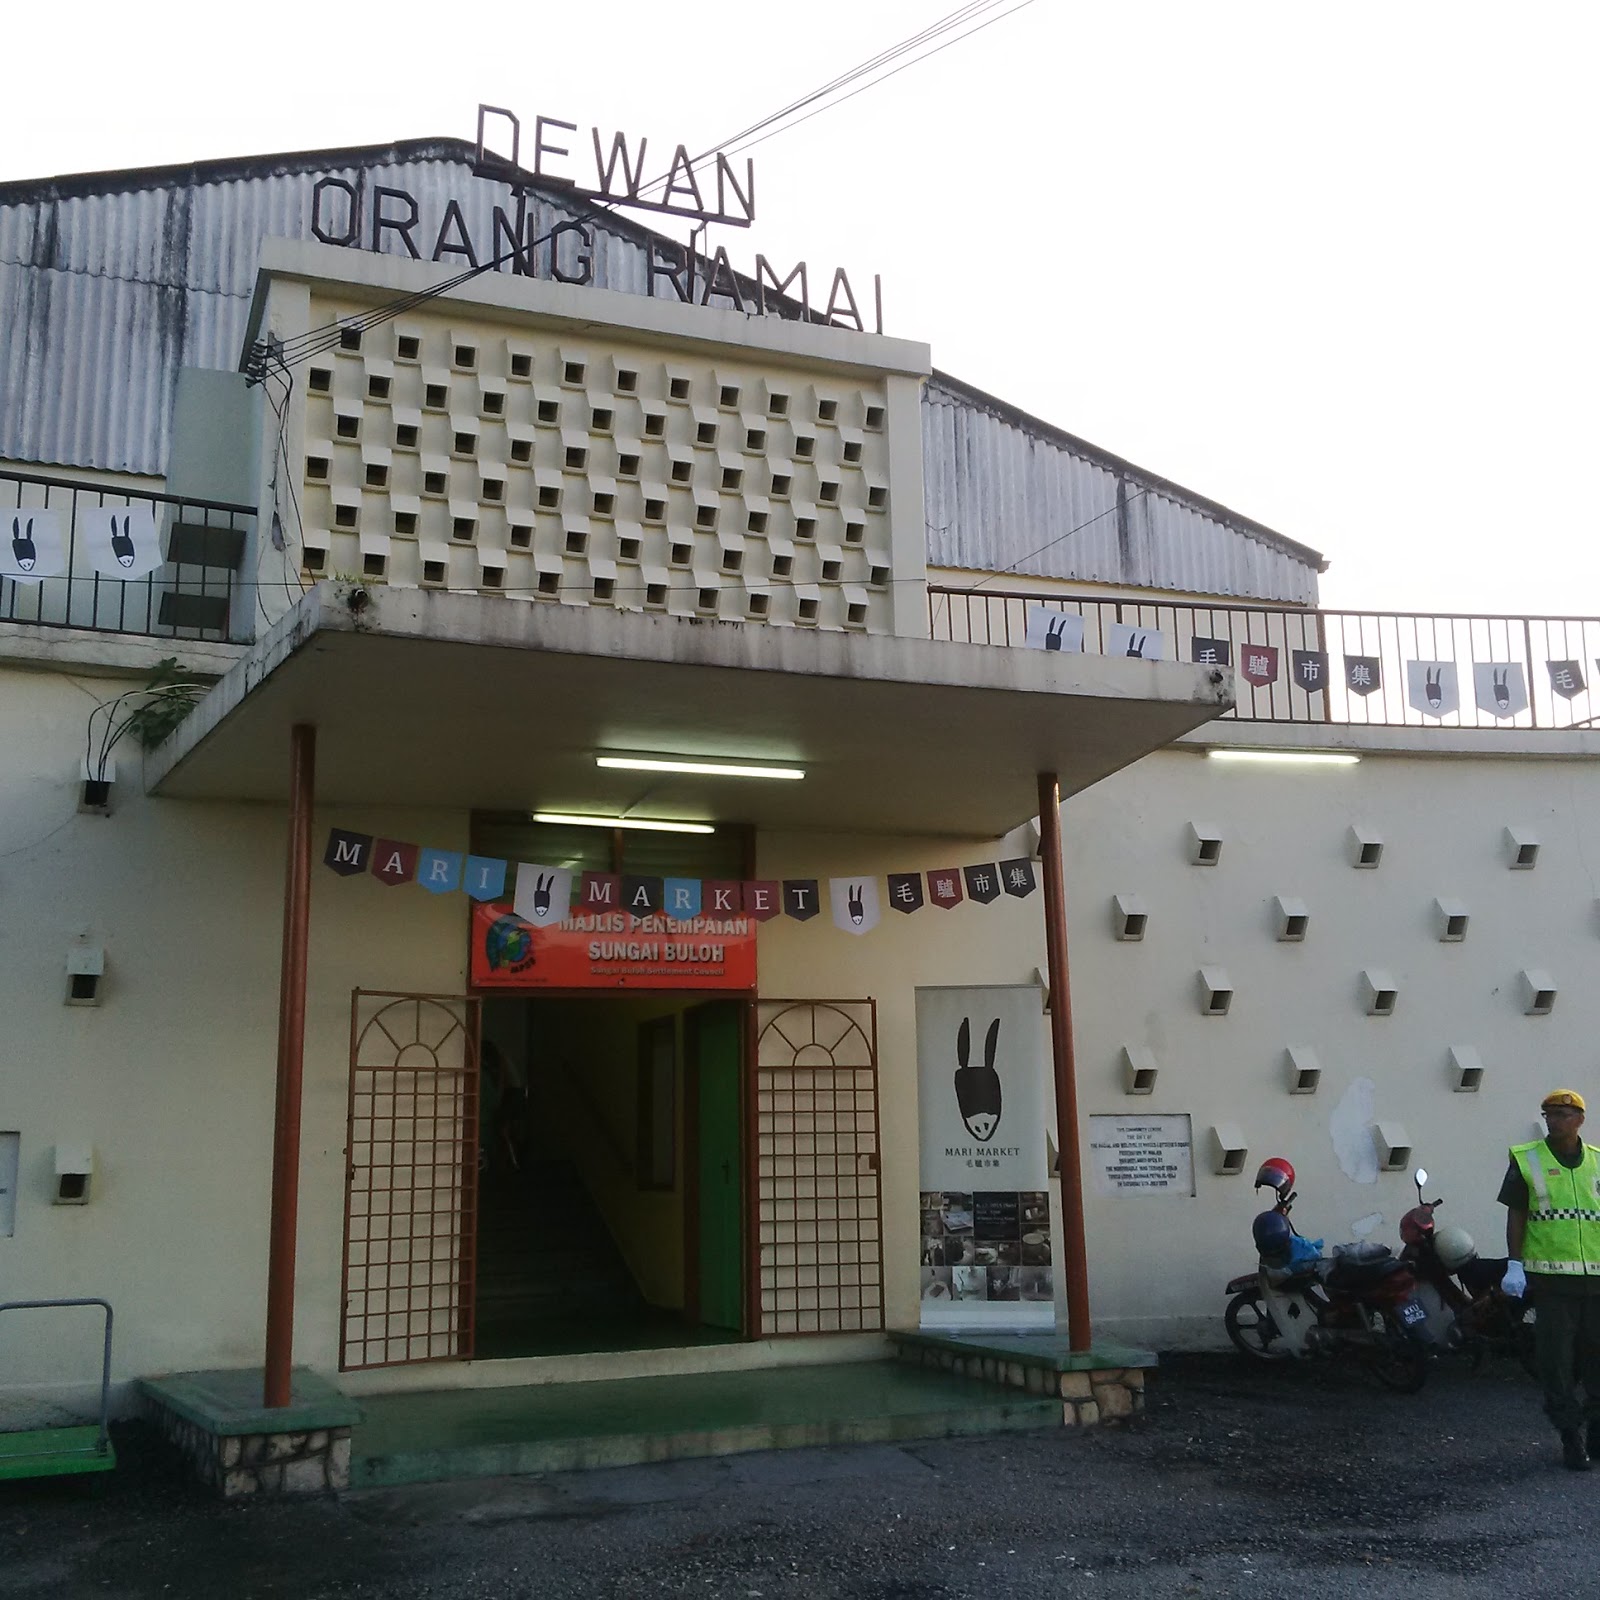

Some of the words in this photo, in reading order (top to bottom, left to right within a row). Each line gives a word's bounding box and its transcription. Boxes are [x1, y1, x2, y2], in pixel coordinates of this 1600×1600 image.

[476, 103, 755, 223] DEWAN
[310, 176, 595, 285] ORANG
[647, 235, 883, 334] RAMAI
[1554, 668, 1575, 689] 毛
[333, 839, 490, 890] MARI
[587, 880, 809, 911] MARKET
[896, 867, 1028, 904] 毛驢市集
[558, 913, 625, 933] MAJLIS
[588, 941, 660, 962] SUNGAI
[664, 943, 725, 963] BULOH
[945, 1147, 972, 1157] MARI
[976, 1147, 1020, 1157] MARKET
